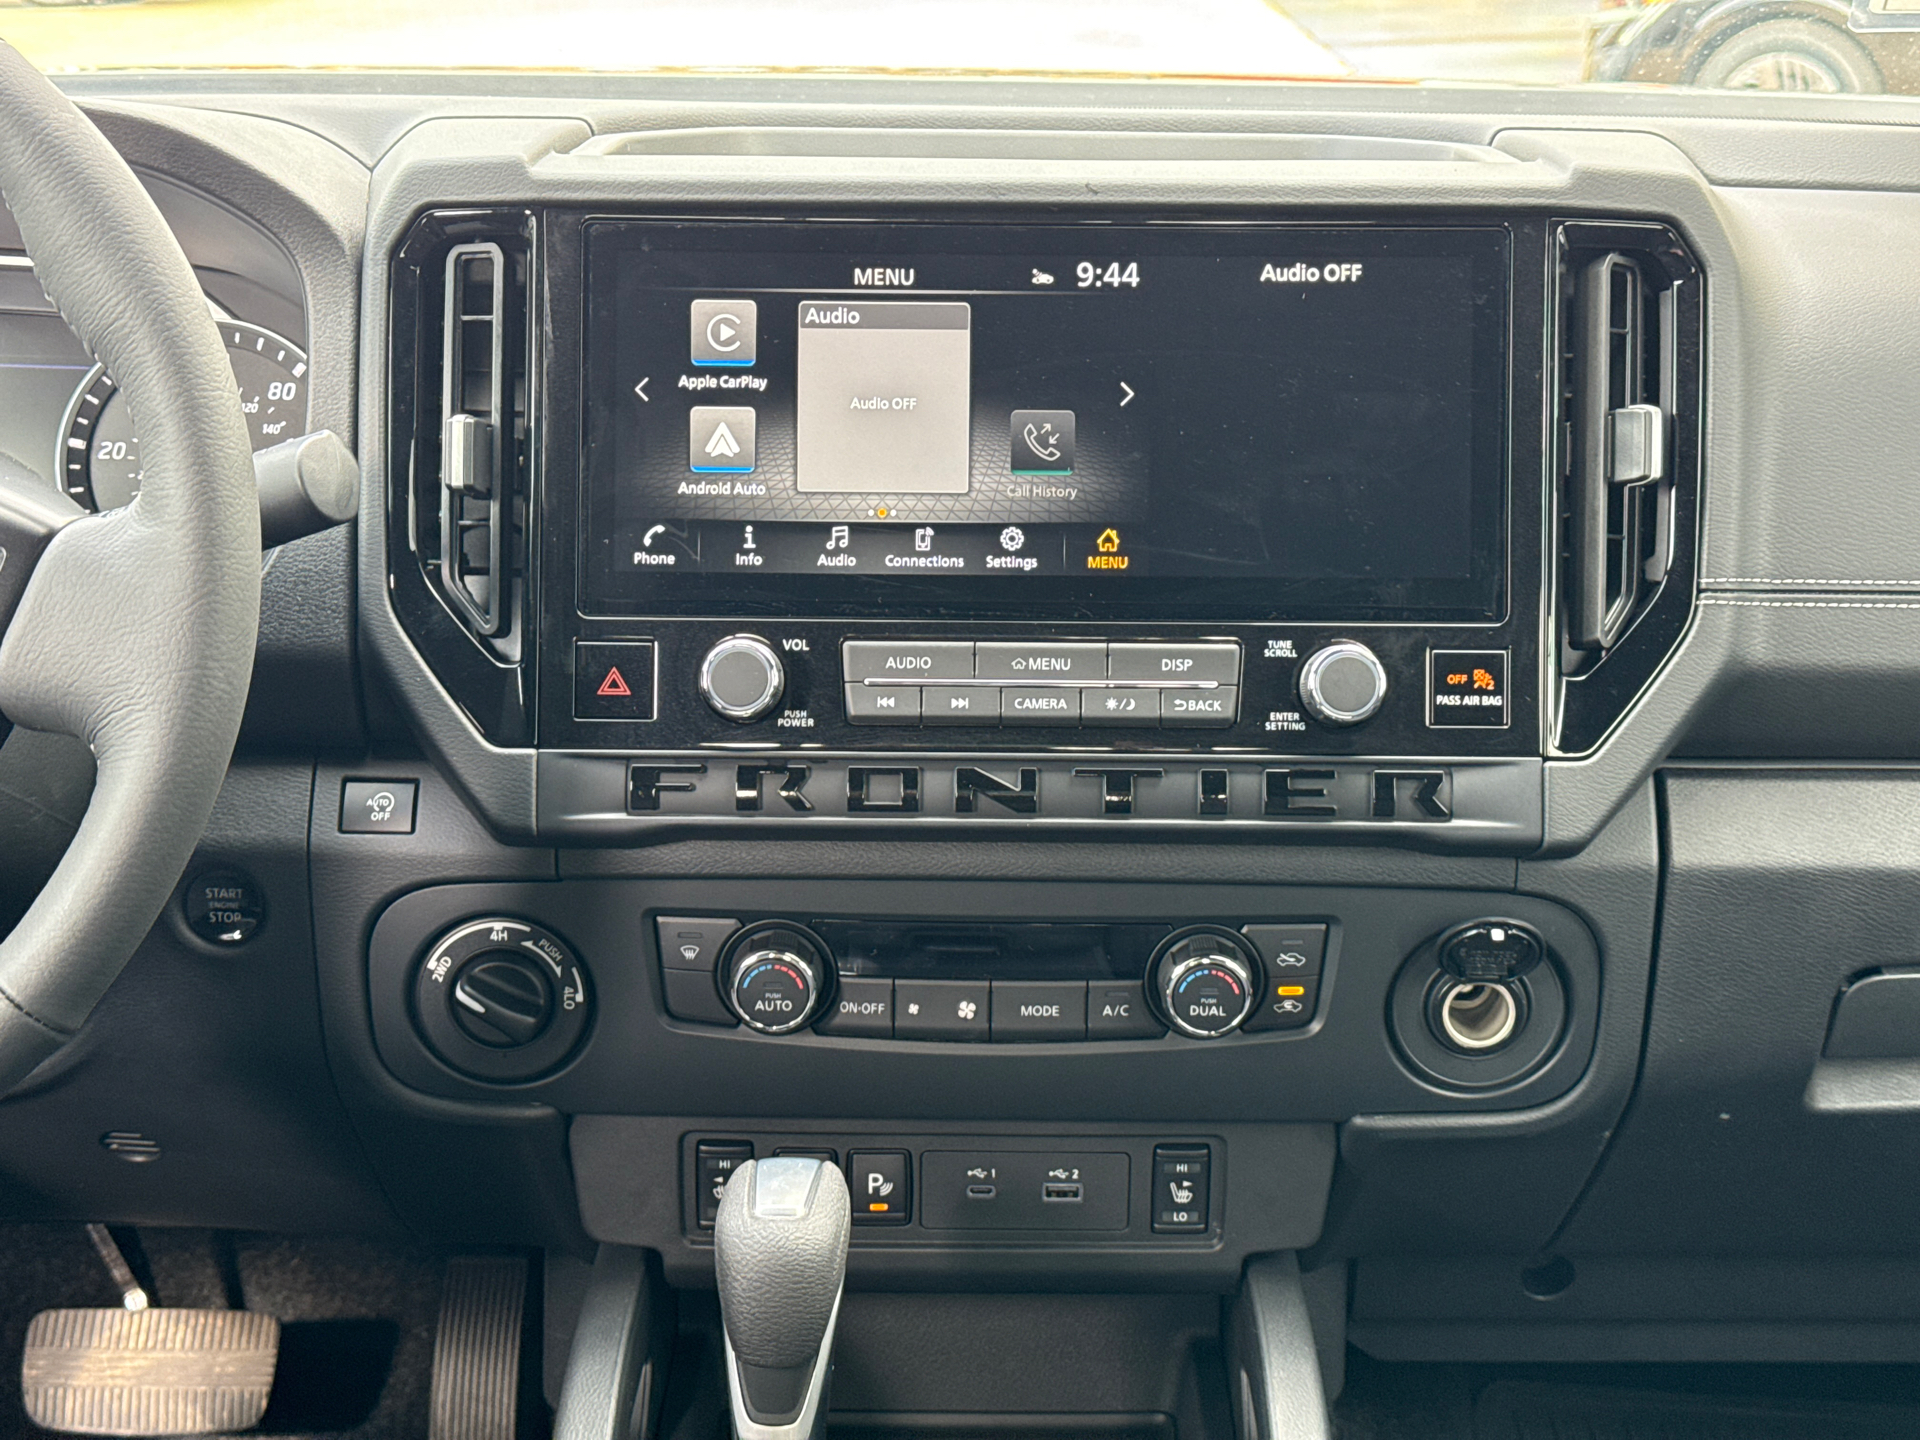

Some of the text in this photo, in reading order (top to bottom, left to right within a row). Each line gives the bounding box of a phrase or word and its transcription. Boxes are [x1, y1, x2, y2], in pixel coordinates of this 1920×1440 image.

[853, 268, 915, 287] MENU
[1075, 261, 1141, 289] 9:44
[1260, 262, 1363, 282] Audio OFF
[804, 307, 861, 326] Audio
[678, 375, 768, 391] Apple CarPlay
[267, 381, 297, 401] 80
[850, 396, 918, 410] Audio OFF
[262, 423, 281, 435] 140
[97, 441, 127, 460] 20
[677, 481, 766, 496] Android Auto
[1007, 484, 1078, 501] Call History
[633, 551, 676, 566] Phone
[735, 552, 763, 567] Info
[817, 553, 857, 568] Audio
[884, 553, 965, 569] Connections
[985, 554, 1038, 572] Settings
[1087, 555, 1129, 570] MENU
[782, 639, 810, 652] VOL
[1267, 640, 1293, 649] TUNE
[1263, 649, 1298, 658] SCROLL
[885, 656, 932, 670] AUDIO
[1028, 657, 1071, 671] MENU
[1161, 658, 1193, 672] DISP
[1446, 673, 1468, 685] OFF
[1014, 697, 1067, 711] CAMERA
[1188, 698, 1222, 712] BACK
[1436, 695, 1503, 706] PASS AIR BAG
[784, 709, 807, 719] PUSH
[1269, 712, 1300, 721] ENTER
[777, 717, 814, 727] POWER
[1264, 721, 1306, 731] SETTING
[629, 763, 1452, 818] FRONTIER
[366, 798, 390, 807] AUTO
[370, 811, 391, 821] OFF
[205, 887, 243, 899] START
[209, 911, 242, 923] STOP
[489, 929, 508, 942] 4H
[538, 938, 563, 962] PUSH
[431, 955, 452, 984] 2WD
[754, 999, 793, 1012] AUTO
[1020, 1004, 1060, 1017] MODE
[1102, 1004, 1130, 1017] A/C
[1189, 1004, 1227, 1017] DUAL
[719, 1160, 731, 1169] HI
[1176, 1164, 1188, 1173] HI
[1071, 1168, 1080, 1179] 2
[1173, 1212, 1188, 1222] LO
